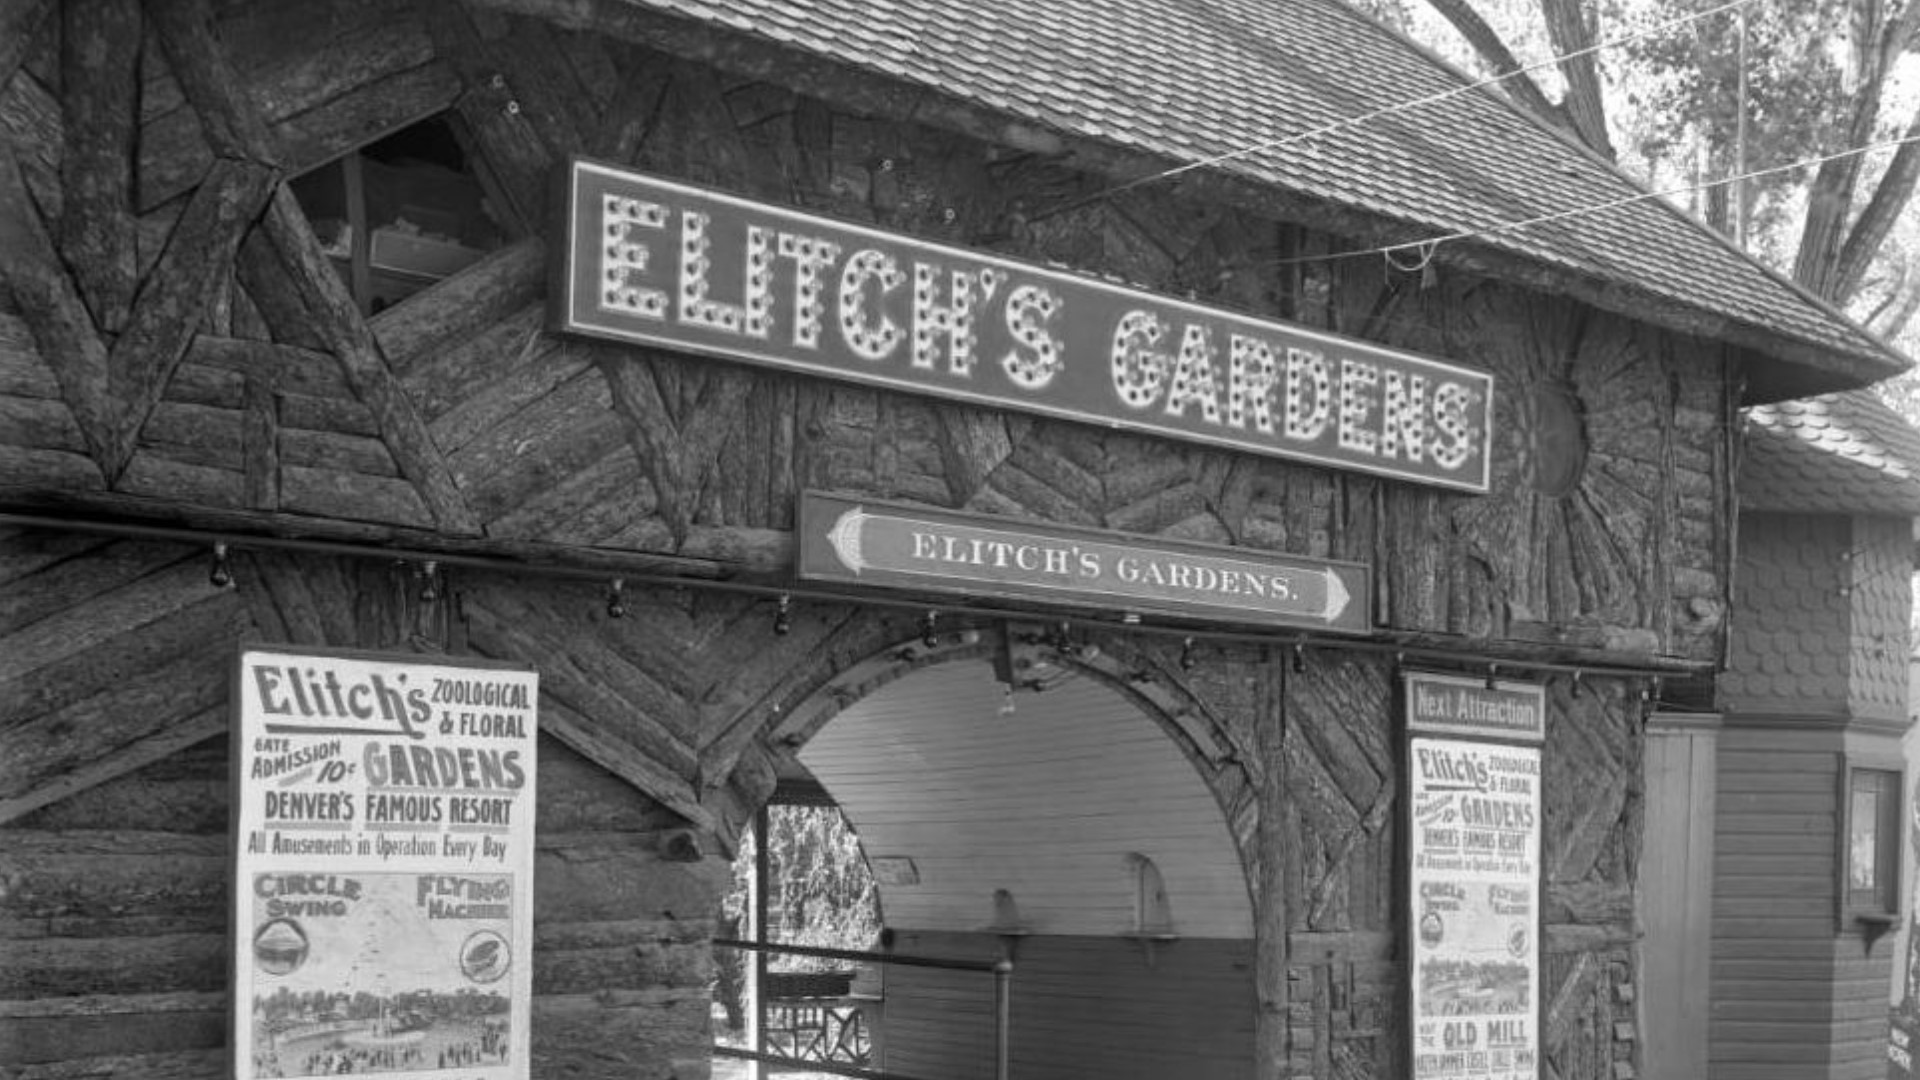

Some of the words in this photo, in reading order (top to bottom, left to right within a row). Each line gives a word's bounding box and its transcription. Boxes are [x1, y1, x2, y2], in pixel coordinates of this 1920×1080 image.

[599, 192, 1064, 389] ELITCH'S
[1111, 309, 1474, 470] GARDENS
[911, 531, 1102, 578] ELITCH'S
[1116, 561, 1299, 601] GARDENS.
[251, 664, 432, 739] Elitch's
[431, 678, 531, 710] ZOOLOGICAL
[1417, 683, 1452, 717] Next
[1458, 689, 1534, 726] Attraction
[438, 711, 455, 734] &
[459, 713, 527, 739] FLORAL
[251, 740, 342, 780] ADMISSION
[363, 741, 525, 789] GARDENS
[265, 790, 354, 821] DENVER'S
[366, 794, 442, 823] FAMOUS
[449, 797, 513, 825] RESORT
[1460, 795, 1534, 828] GARDENS
[254, 873, 362, 901] CIRCLE
[1444, 1021, 1478, 1048] OLD
[1487, 1019, 1528, 1043] MILL
